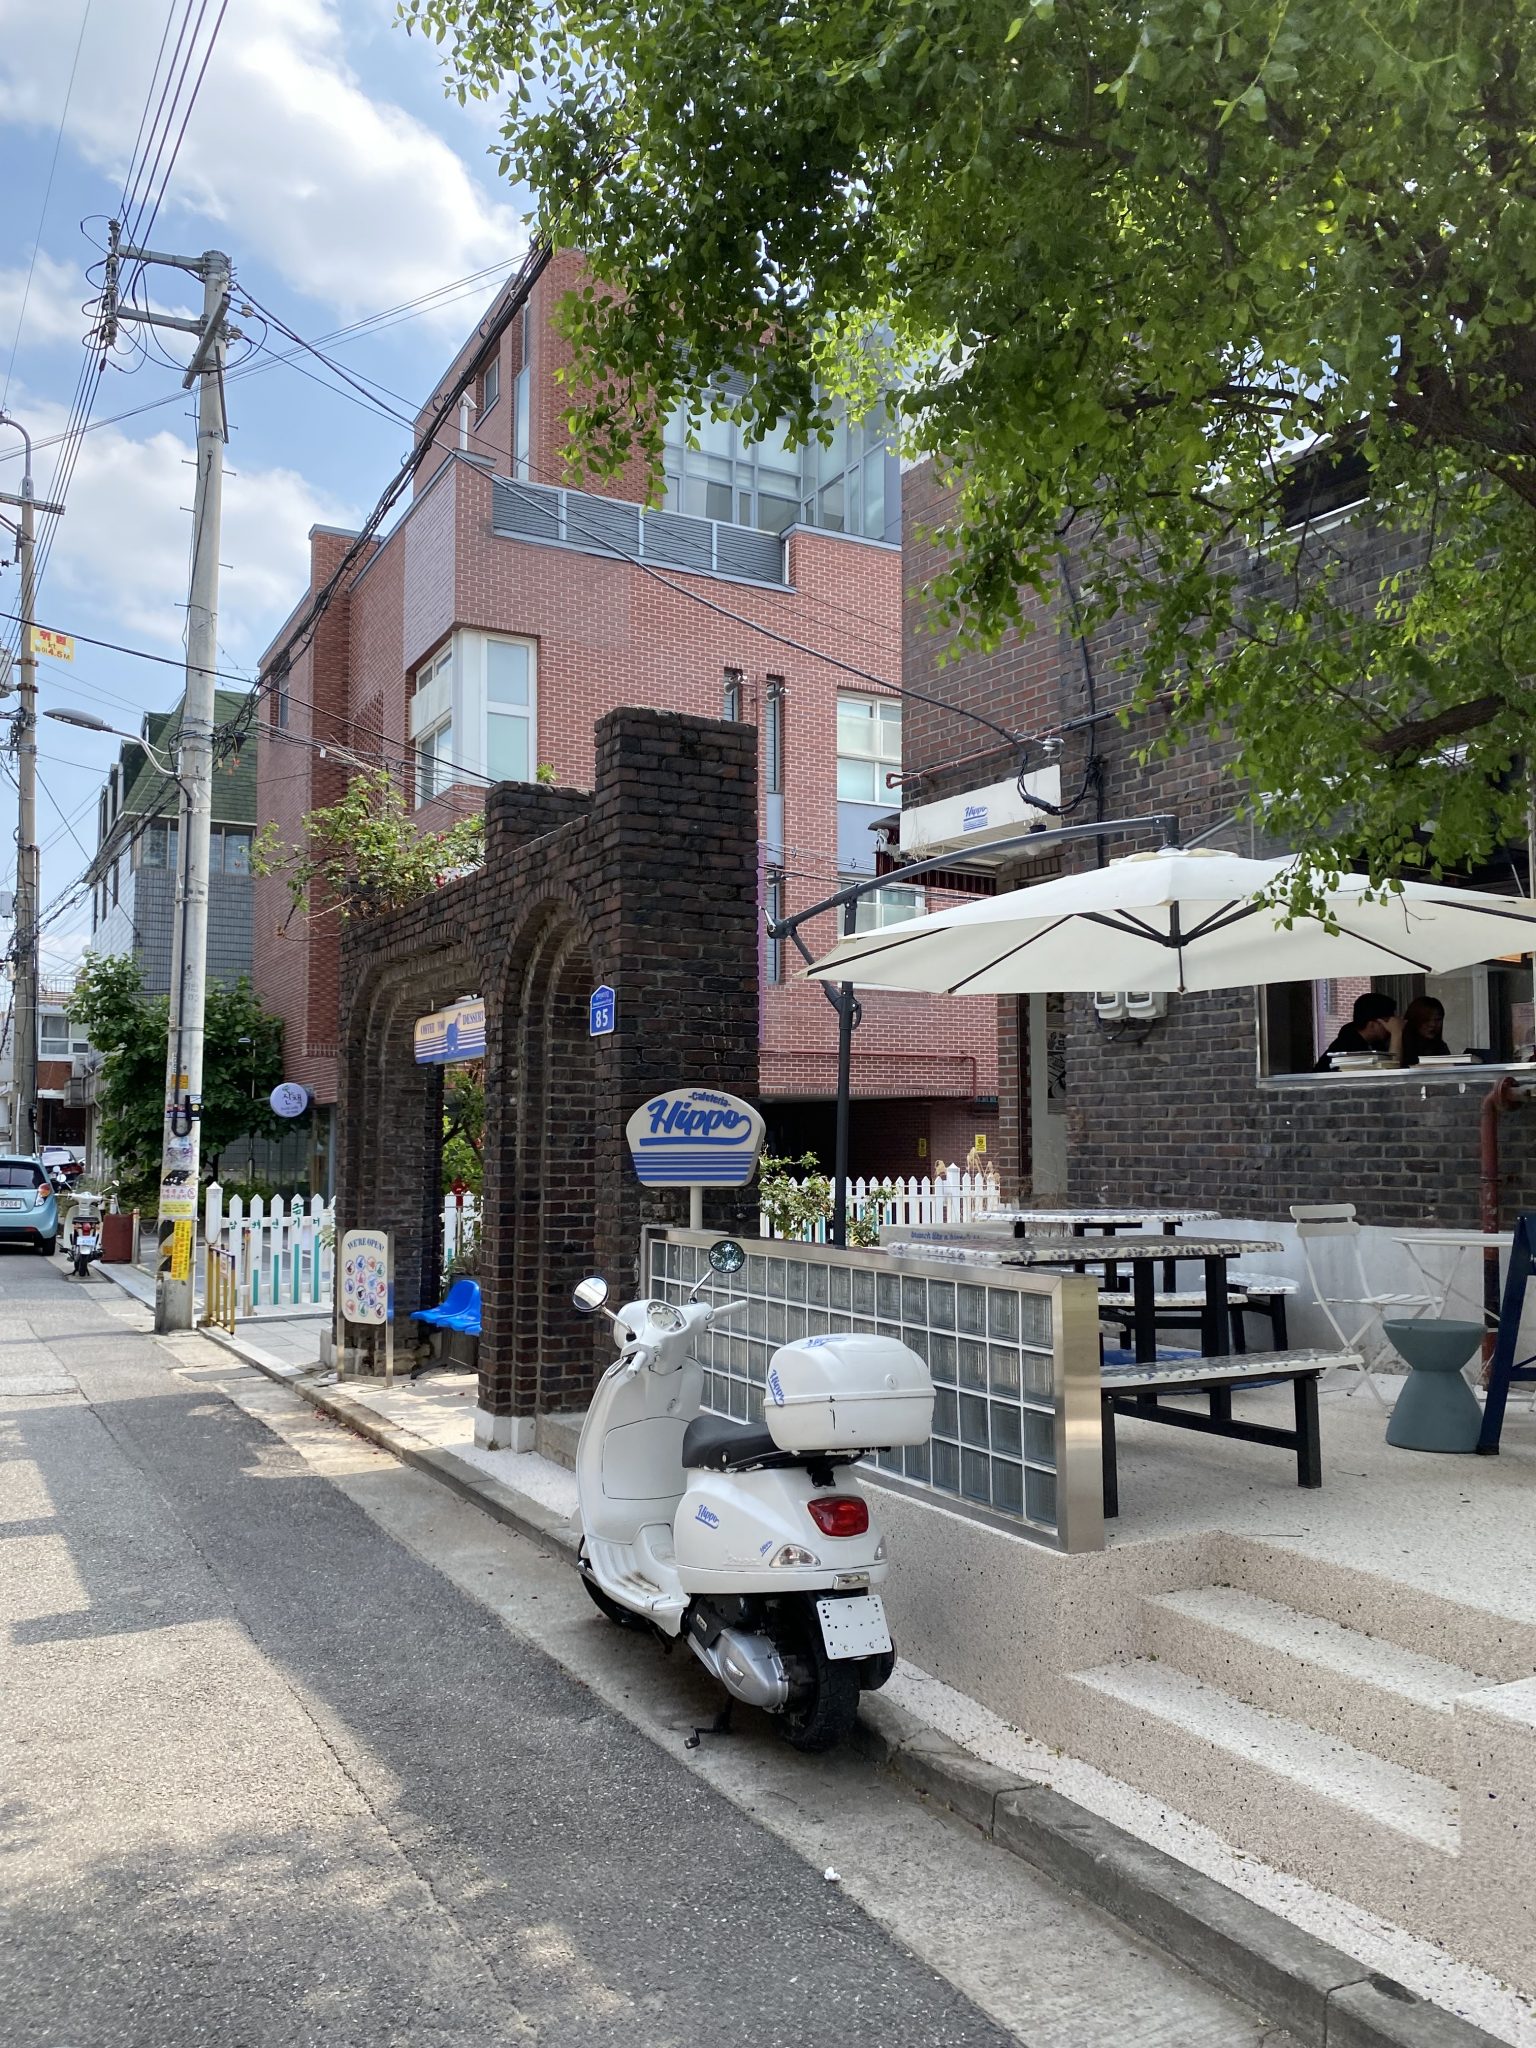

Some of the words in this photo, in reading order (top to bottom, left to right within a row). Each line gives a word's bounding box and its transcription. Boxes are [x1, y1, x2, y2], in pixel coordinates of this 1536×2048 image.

[462, 1011, 484, 1026] DESSERT
[595, 1008, 609, 1028] 85
[646, 1099, 752, 1138] Hippo
[695, 1504, 720, 1526] Hippo
